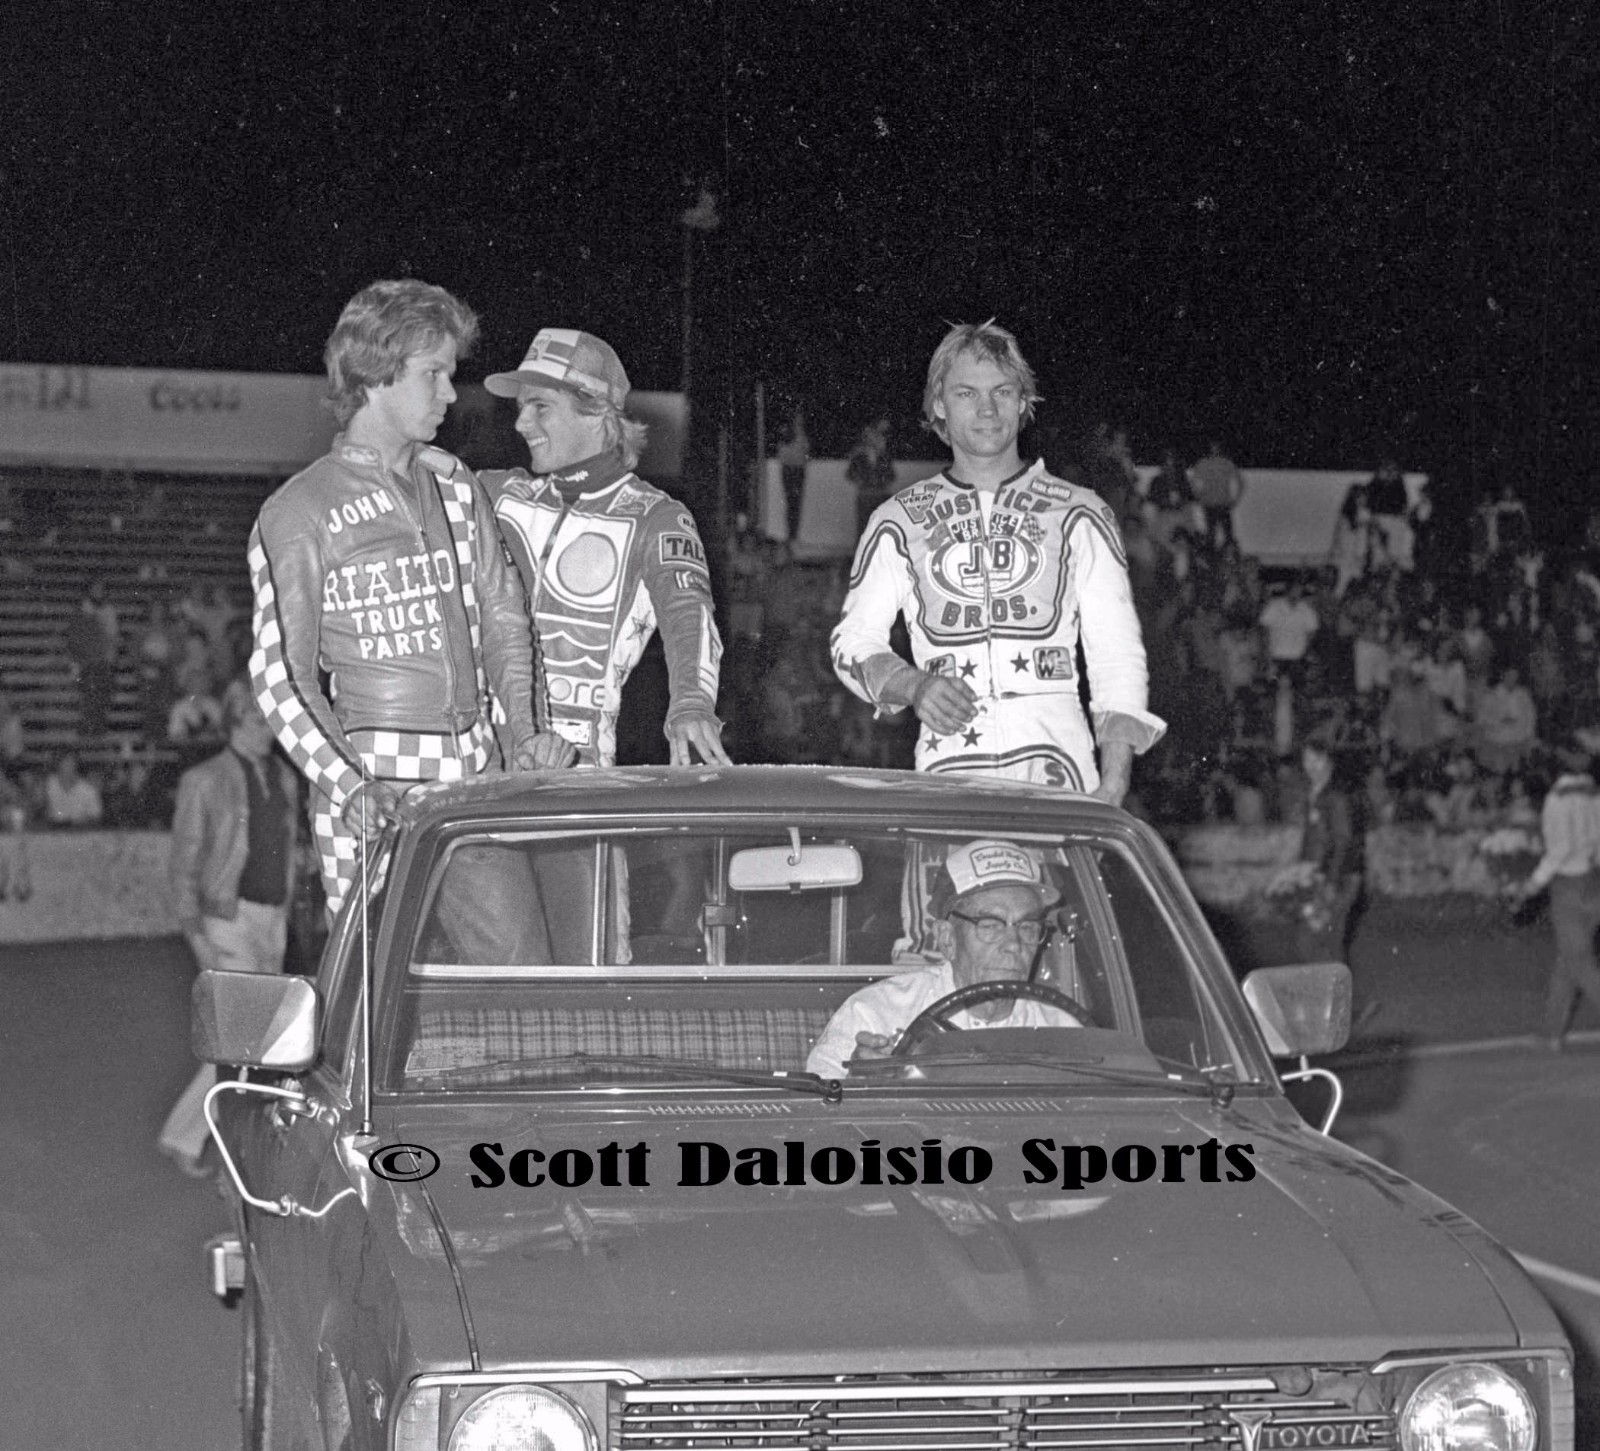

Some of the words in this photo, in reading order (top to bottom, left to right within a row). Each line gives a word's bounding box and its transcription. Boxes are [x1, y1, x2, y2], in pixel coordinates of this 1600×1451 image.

[328, 489, 394, 534] JOHN
[323, 549, 455, 612] RIALTO
[351, 598, 442, 634] TRUCK
[941, 594, 1038, 629] BROS.
[359, 626, 442, 660] PARTS
[1263, 1424, 1370, 1449] TOYOTA
